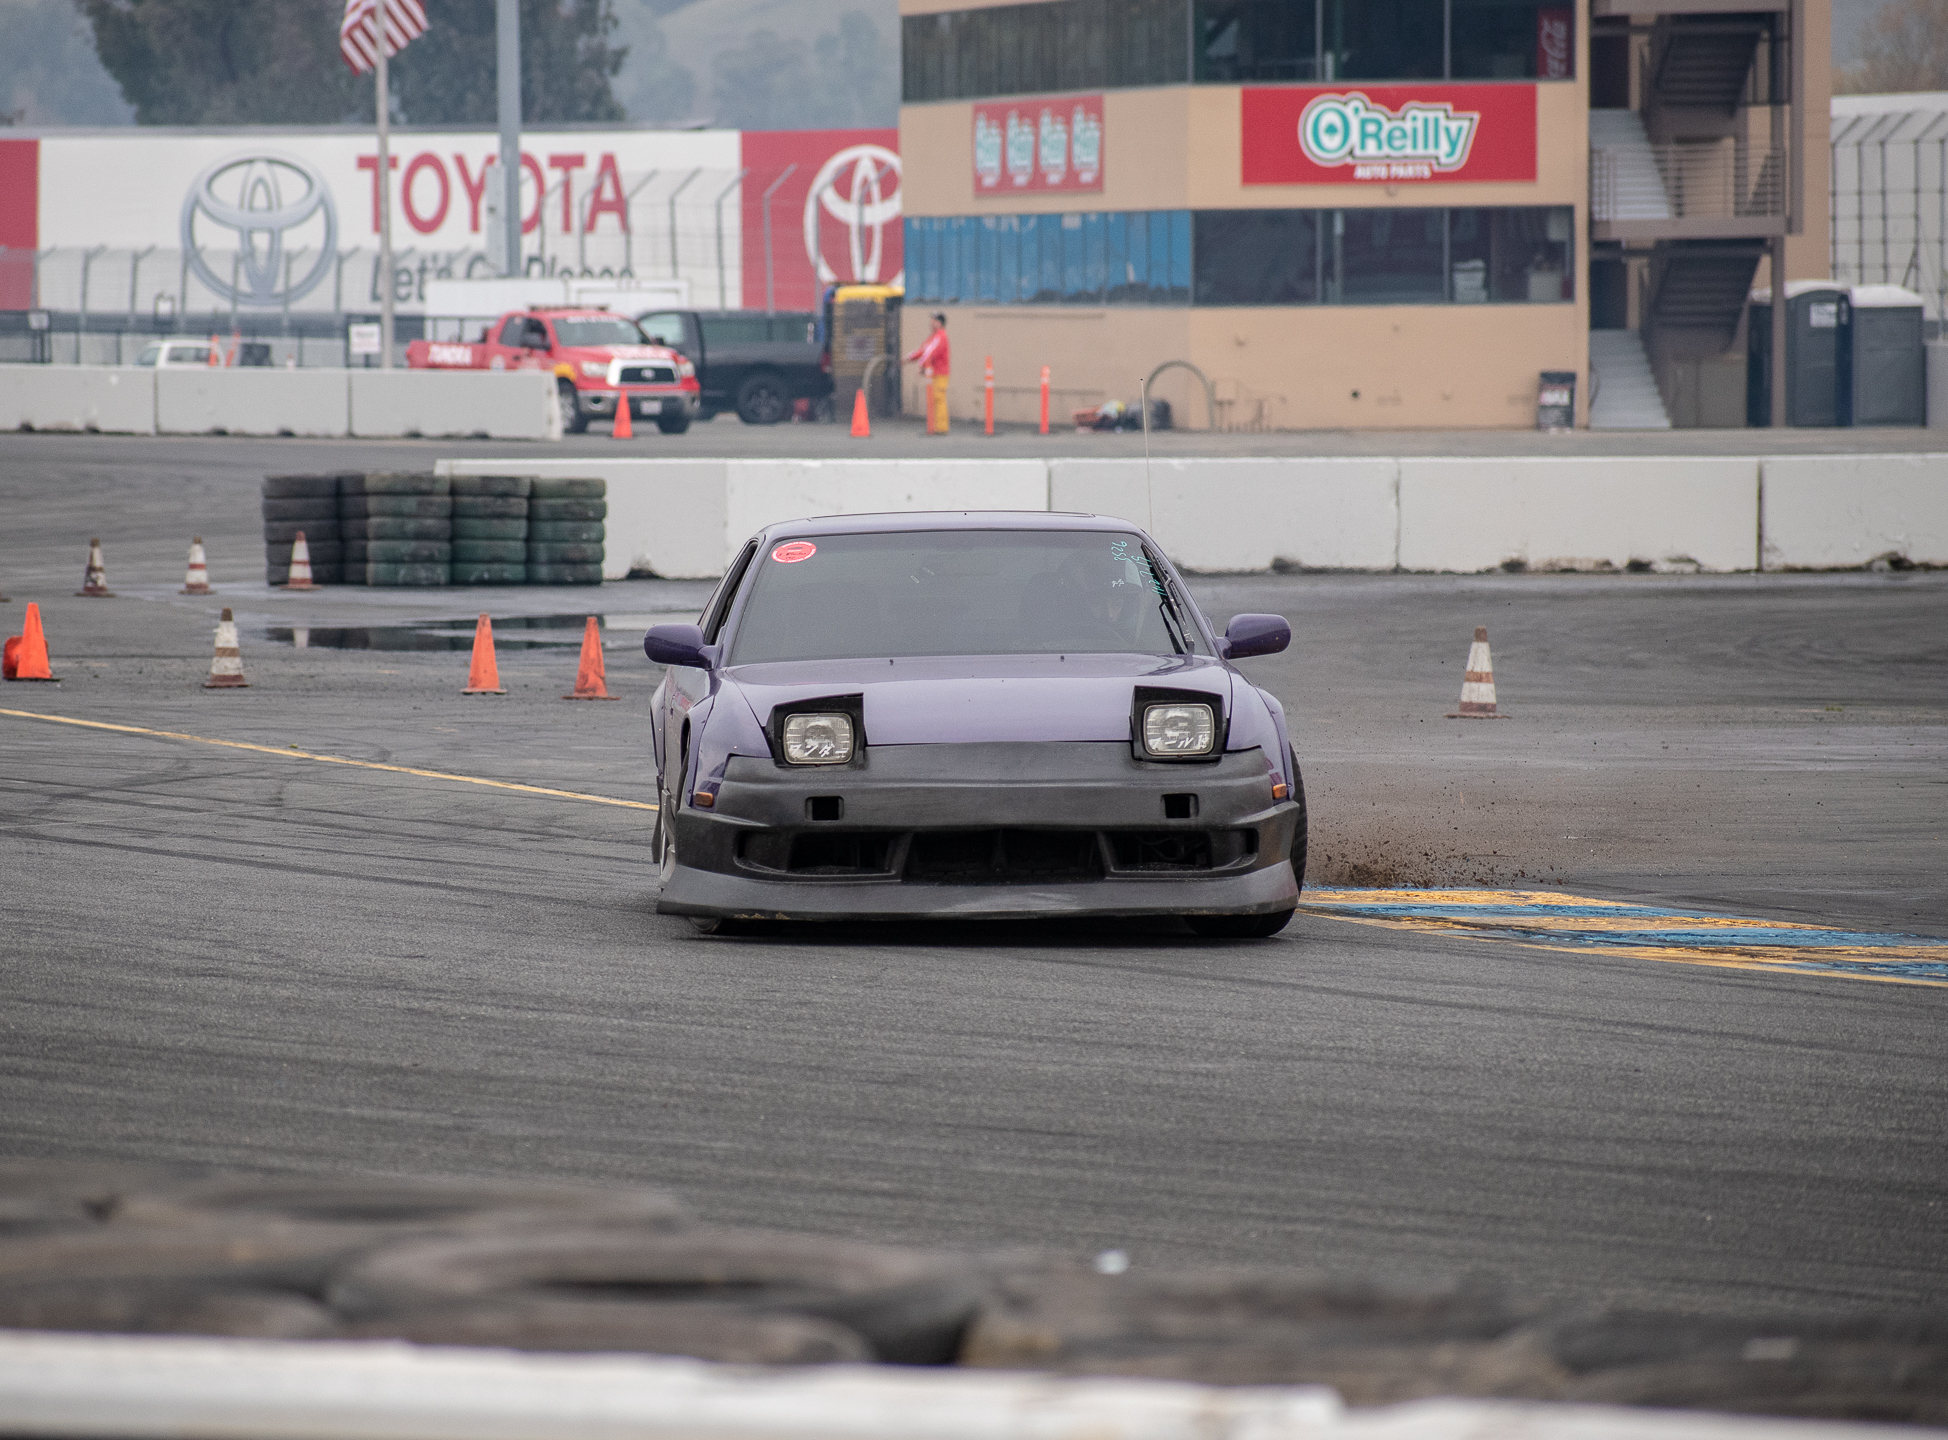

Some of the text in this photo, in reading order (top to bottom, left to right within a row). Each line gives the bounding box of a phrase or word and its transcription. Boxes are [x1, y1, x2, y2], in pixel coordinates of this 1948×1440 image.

[1308, 102, 1468, 162] O'Reilly
[1354, 163, 1431, 179] AUTO PARTS
